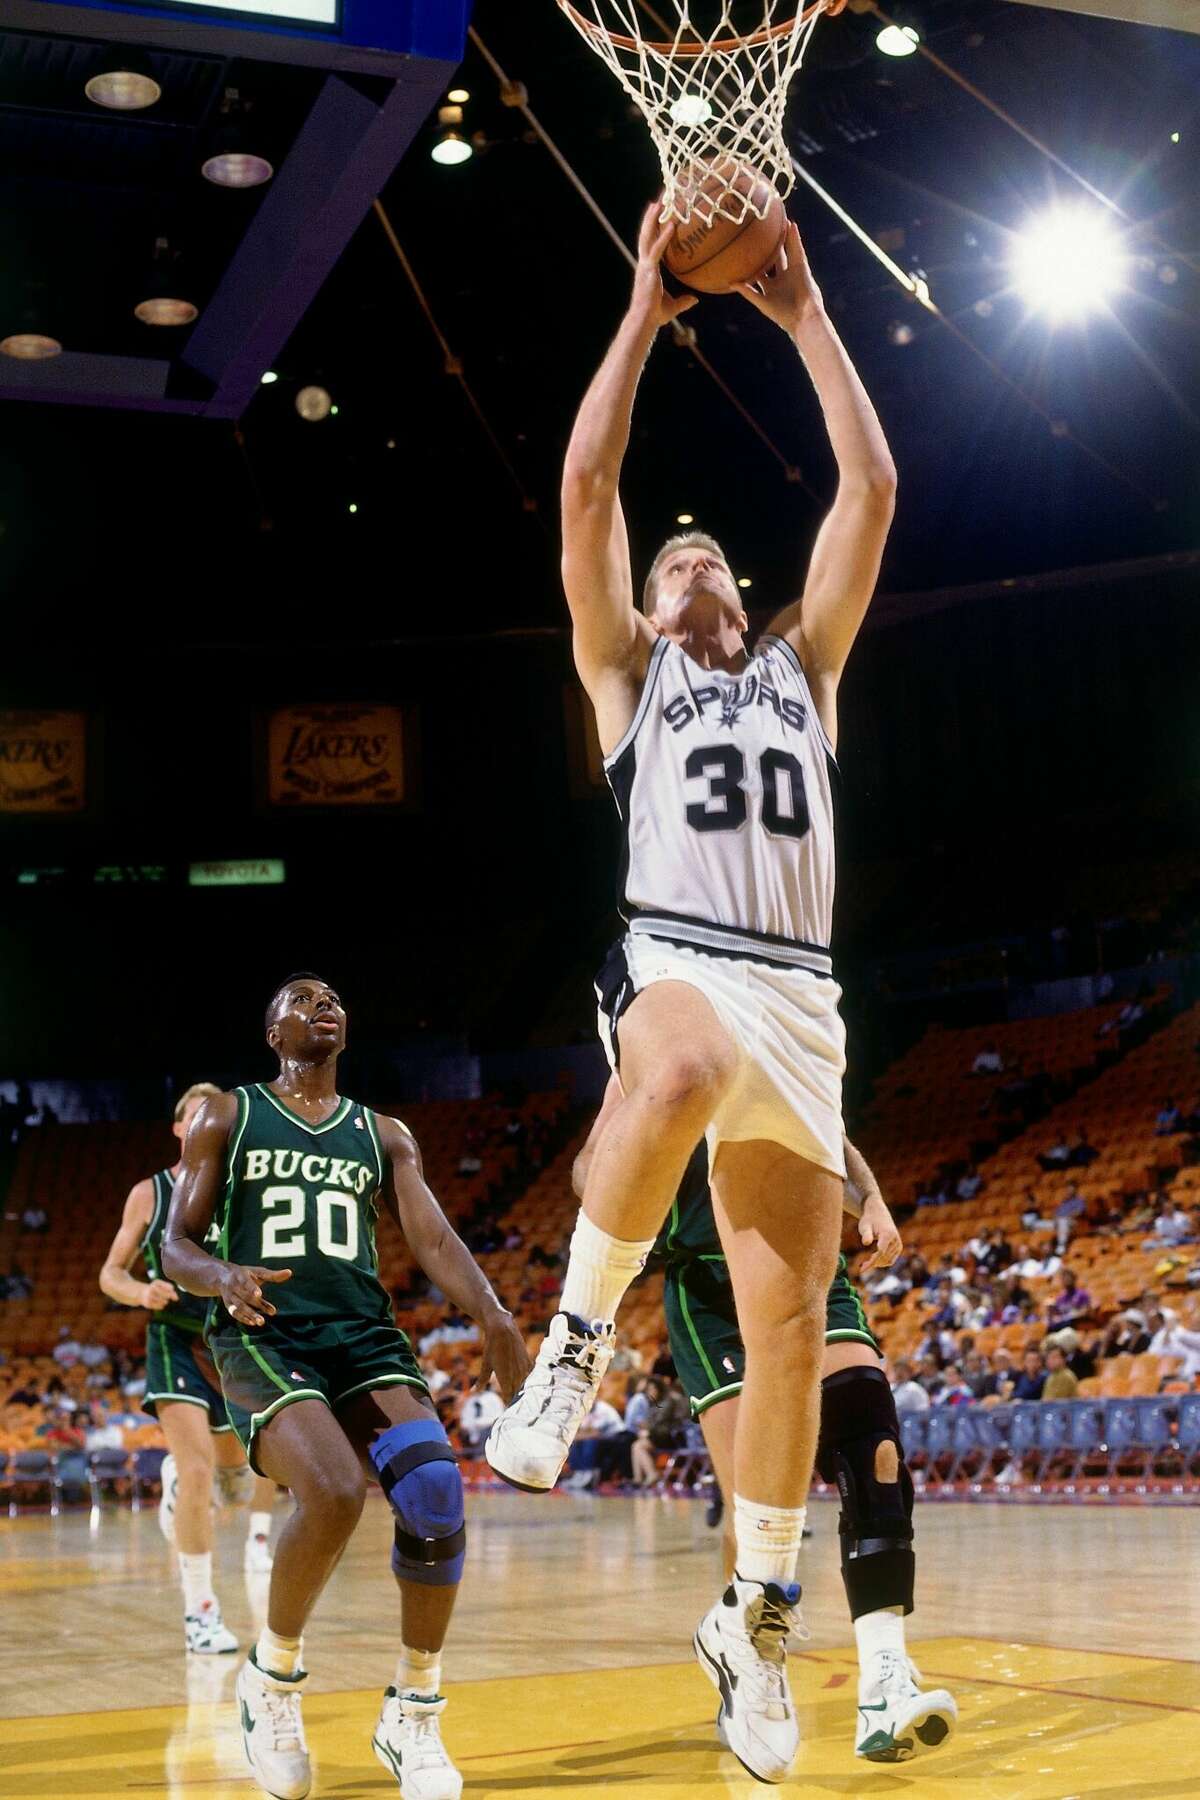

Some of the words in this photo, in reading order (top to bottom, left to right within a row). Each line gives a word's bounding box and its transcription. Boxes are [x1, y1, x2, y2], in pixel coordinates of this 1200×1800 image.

[663, 674, 807, 733] SPURS
[282, 725, 389, 767] LAKERS
[684, 743, 811, 840] 30
[243, 1149, 375, 1195] BUCKS
[261, 1185, 359, 1262] 20
